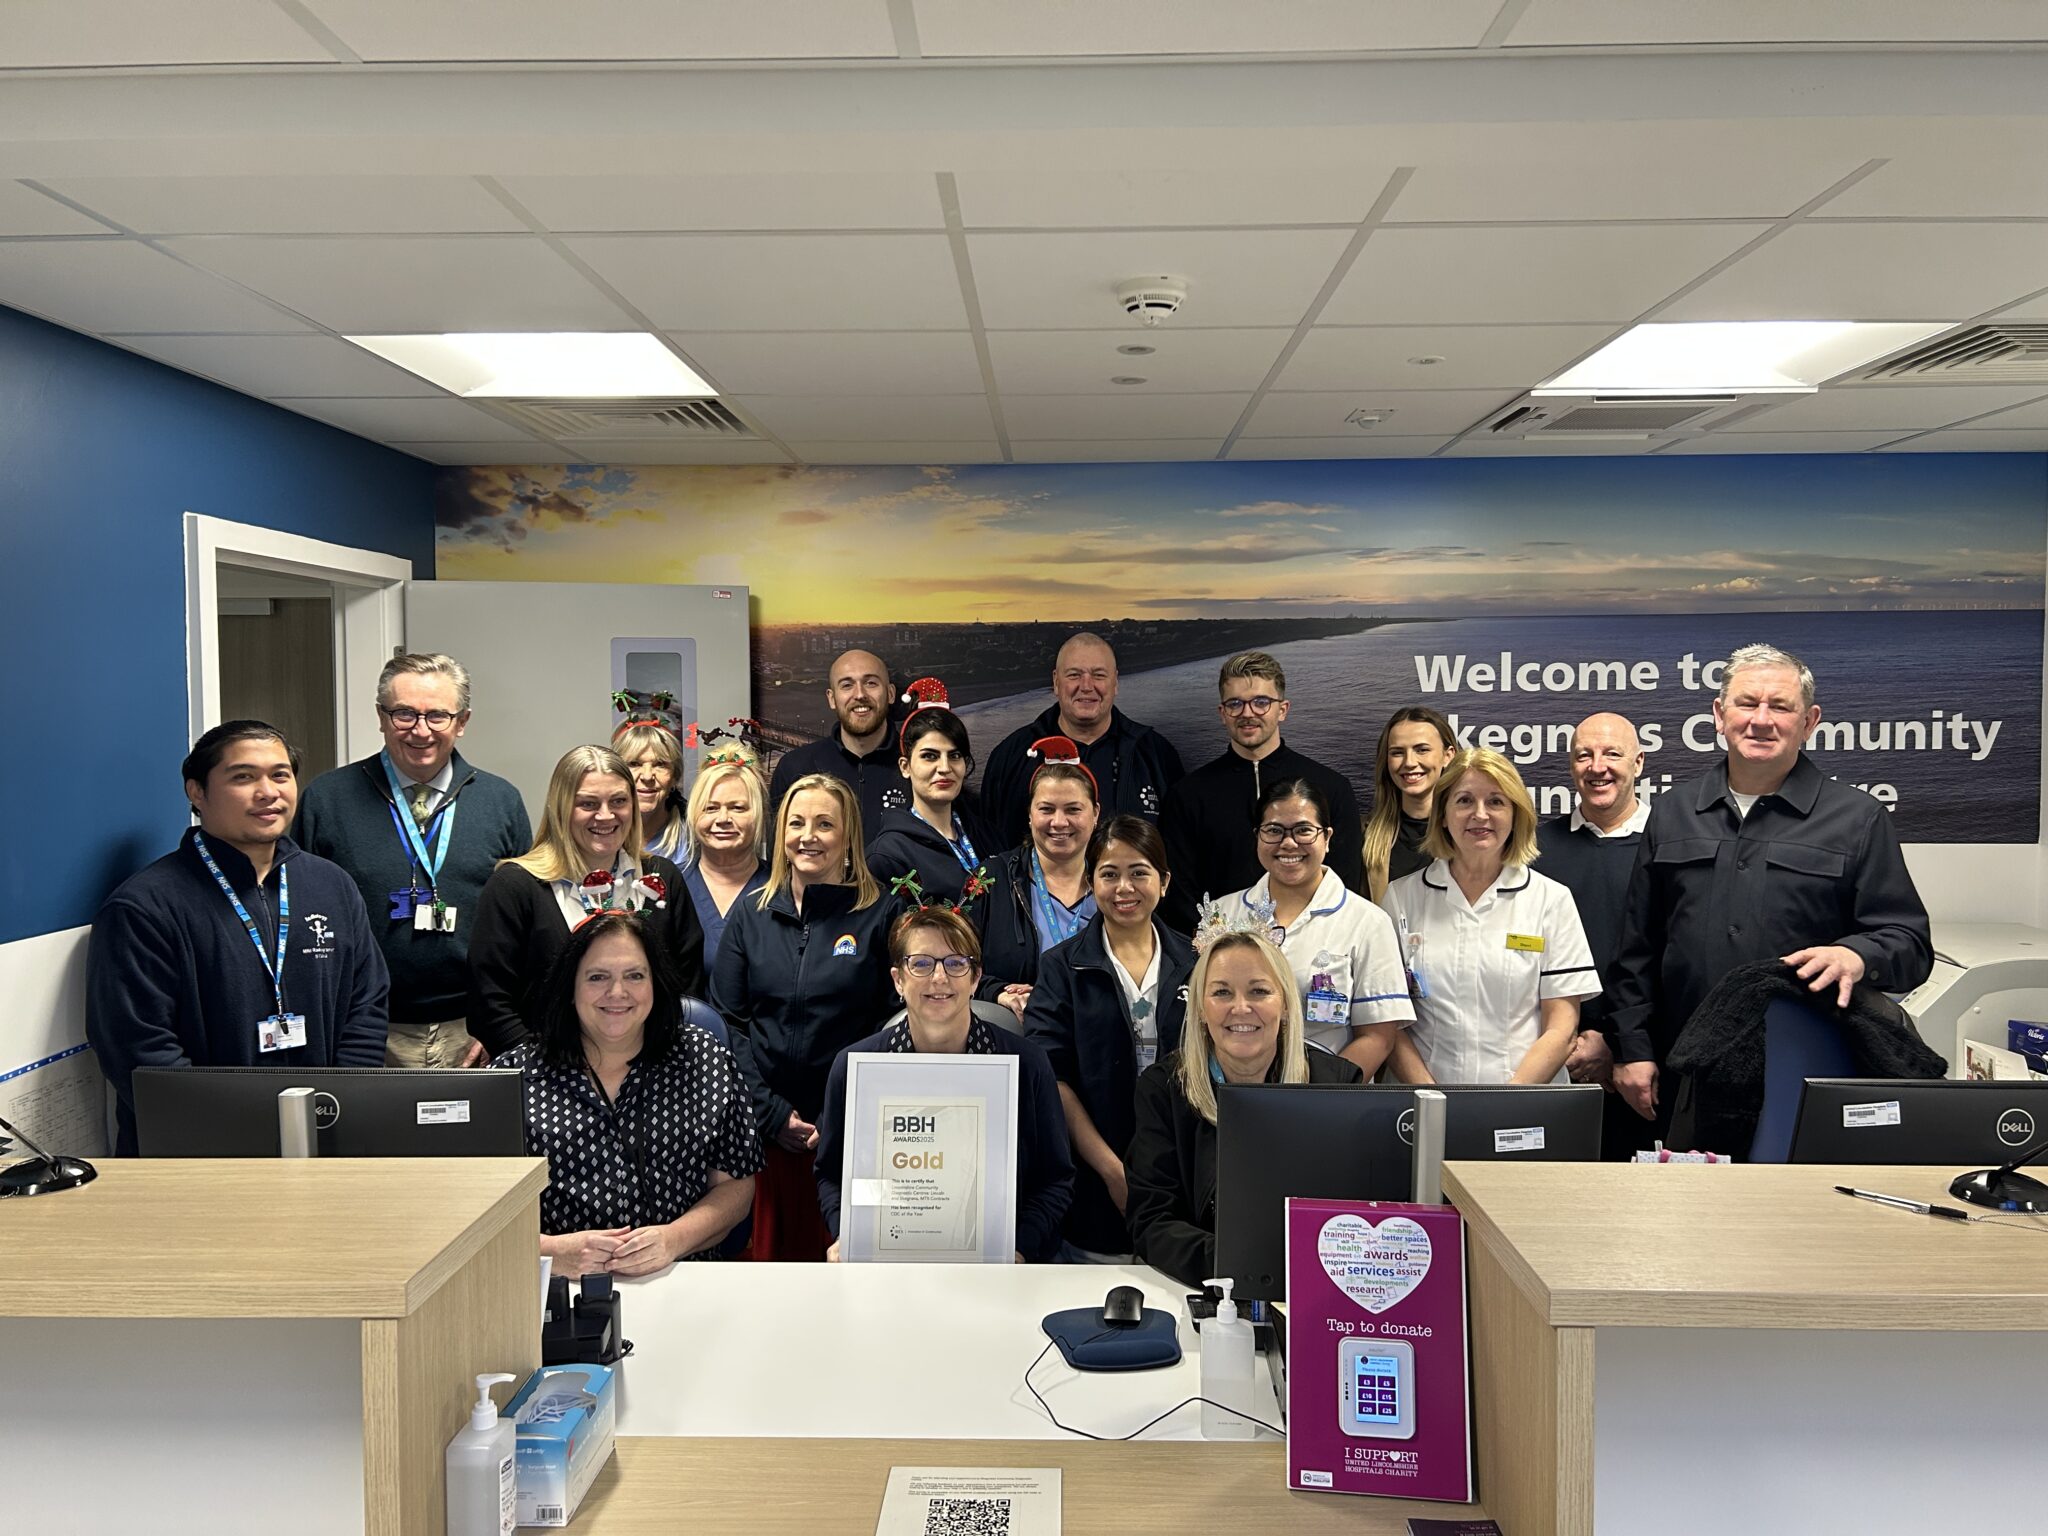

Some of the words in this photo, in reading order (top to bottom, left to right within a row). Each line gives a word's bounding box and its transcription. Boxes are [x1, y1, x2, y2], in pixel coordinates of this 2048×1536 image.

[1414, 651, 1660, 693] Welcome
[217, 876, 231, 890] NHS
[836, 946, 854, 954] NHS
[893, 1116, 935, 1132] BBH
[2002, 1122, 2030, 1133] DELL
[892, 1152, 944, 1170] Gold
[1324, 1230, 1355, 1240] training
[1382, 1226, 1412, 1235] friendship
[1382, 1234, 1402, 1242] better
[1336, 1244, 1362, 1252] health
[1364, 1250, 1408, 1261] awards
[1330, 1268, 1344, 1276] aid
[1348, 1266, 1395, 1276] services
[1396, 1268, 1421, 1276] assist
[1364, 1279, 1409, 1287] developments
[1346, 1286, 1386, 1295] research
[1327, 1318, 1355, 1336] Tap
[1360, 1320, 1375, 1333] to
[1380, 1322, 1432, 1337] donate
[1344, 1447, 1351, 1458] I
[1371, 1461, 1418, 1470] LINCOLNSHIRE
[1345, 1466, 1383, 1475] HOSPITALS
